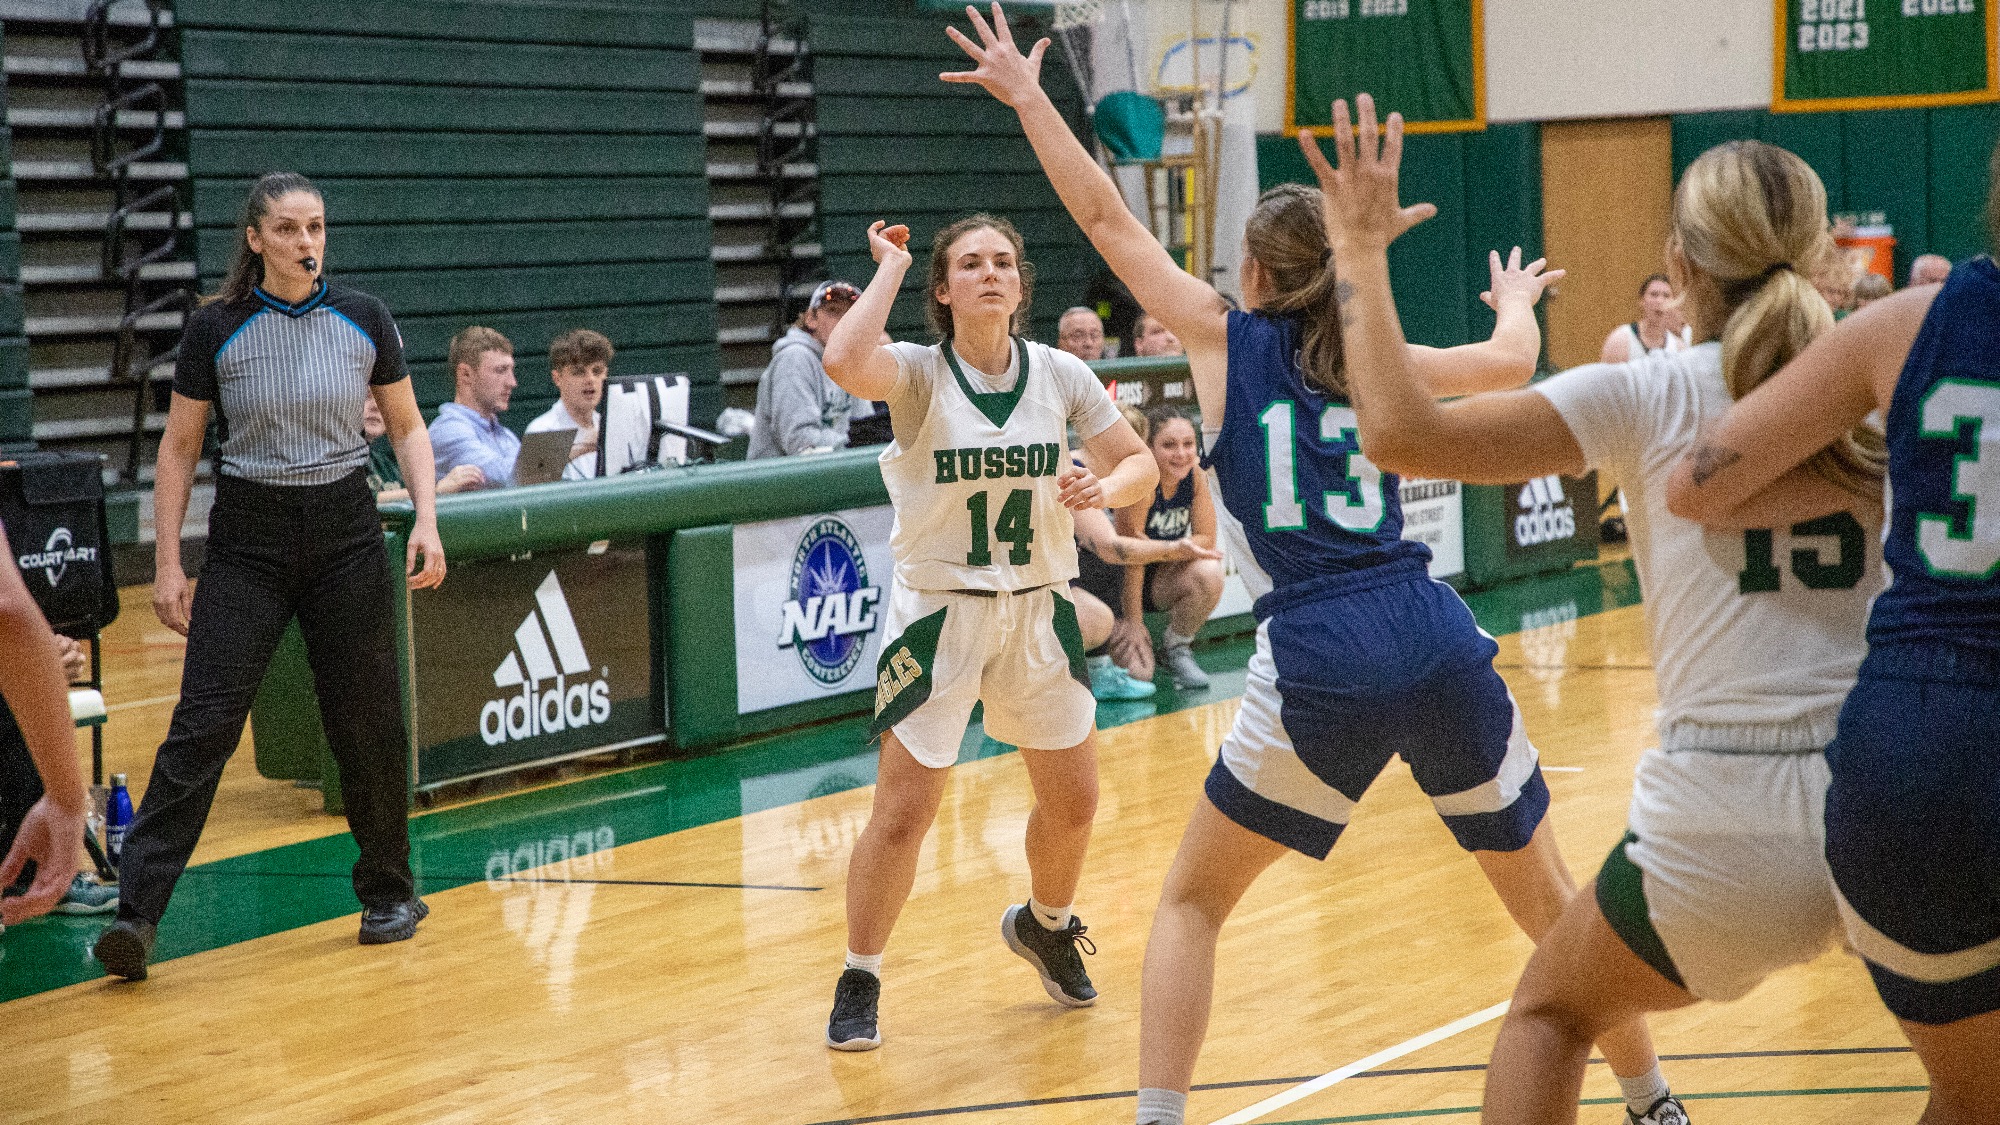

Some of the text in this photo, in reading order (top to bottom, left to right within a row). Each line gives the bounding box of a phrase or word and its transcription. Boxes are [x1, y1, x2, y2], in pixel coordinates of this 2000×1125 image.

[1798, 22, 1869, 51] 2023
[1802, 0, 1866, 21] 2021
[933, 442, 1061, 485] HUSSON
[1257, 399, 1387, 533] 13
[791, 521, 867, 590] NORTH ATLANTIC
[966, 488, 1035, 567] 14
[1514, 503, 1576, 548] adidas
[1738, 511, 1866, 595] 15
[777, 585, 881, 649] NAC
[479, 673, 612, 747] adidas
[874, 645, 923, 721] AGLES
